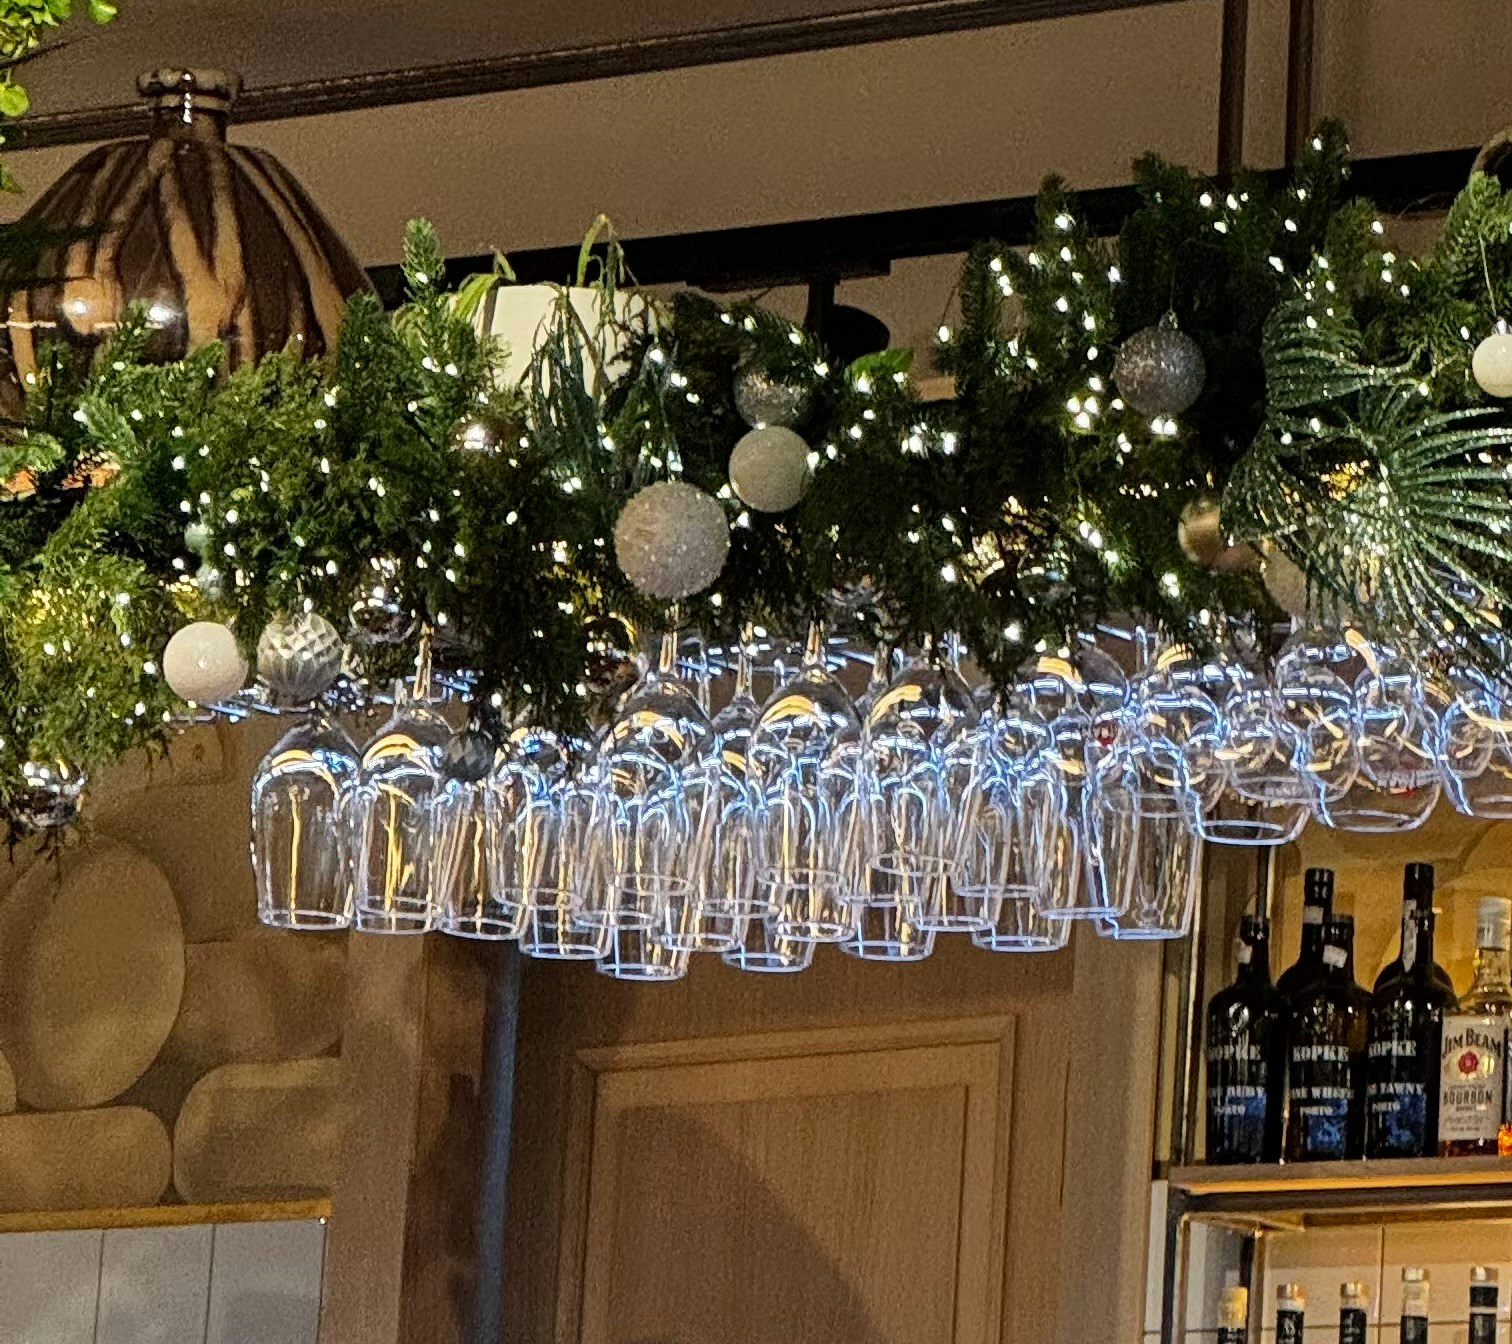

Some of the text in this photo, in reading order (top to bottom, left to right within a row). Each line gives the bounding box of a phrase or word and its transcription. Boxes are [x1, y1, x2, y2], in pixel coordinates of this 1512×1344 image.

[1443, 1027, 1502, 1060] JIM BEAM
[1292, 1044, 1349, 1062] KOPKE
[1442, 1088, 1493, 1106] BOURBON
